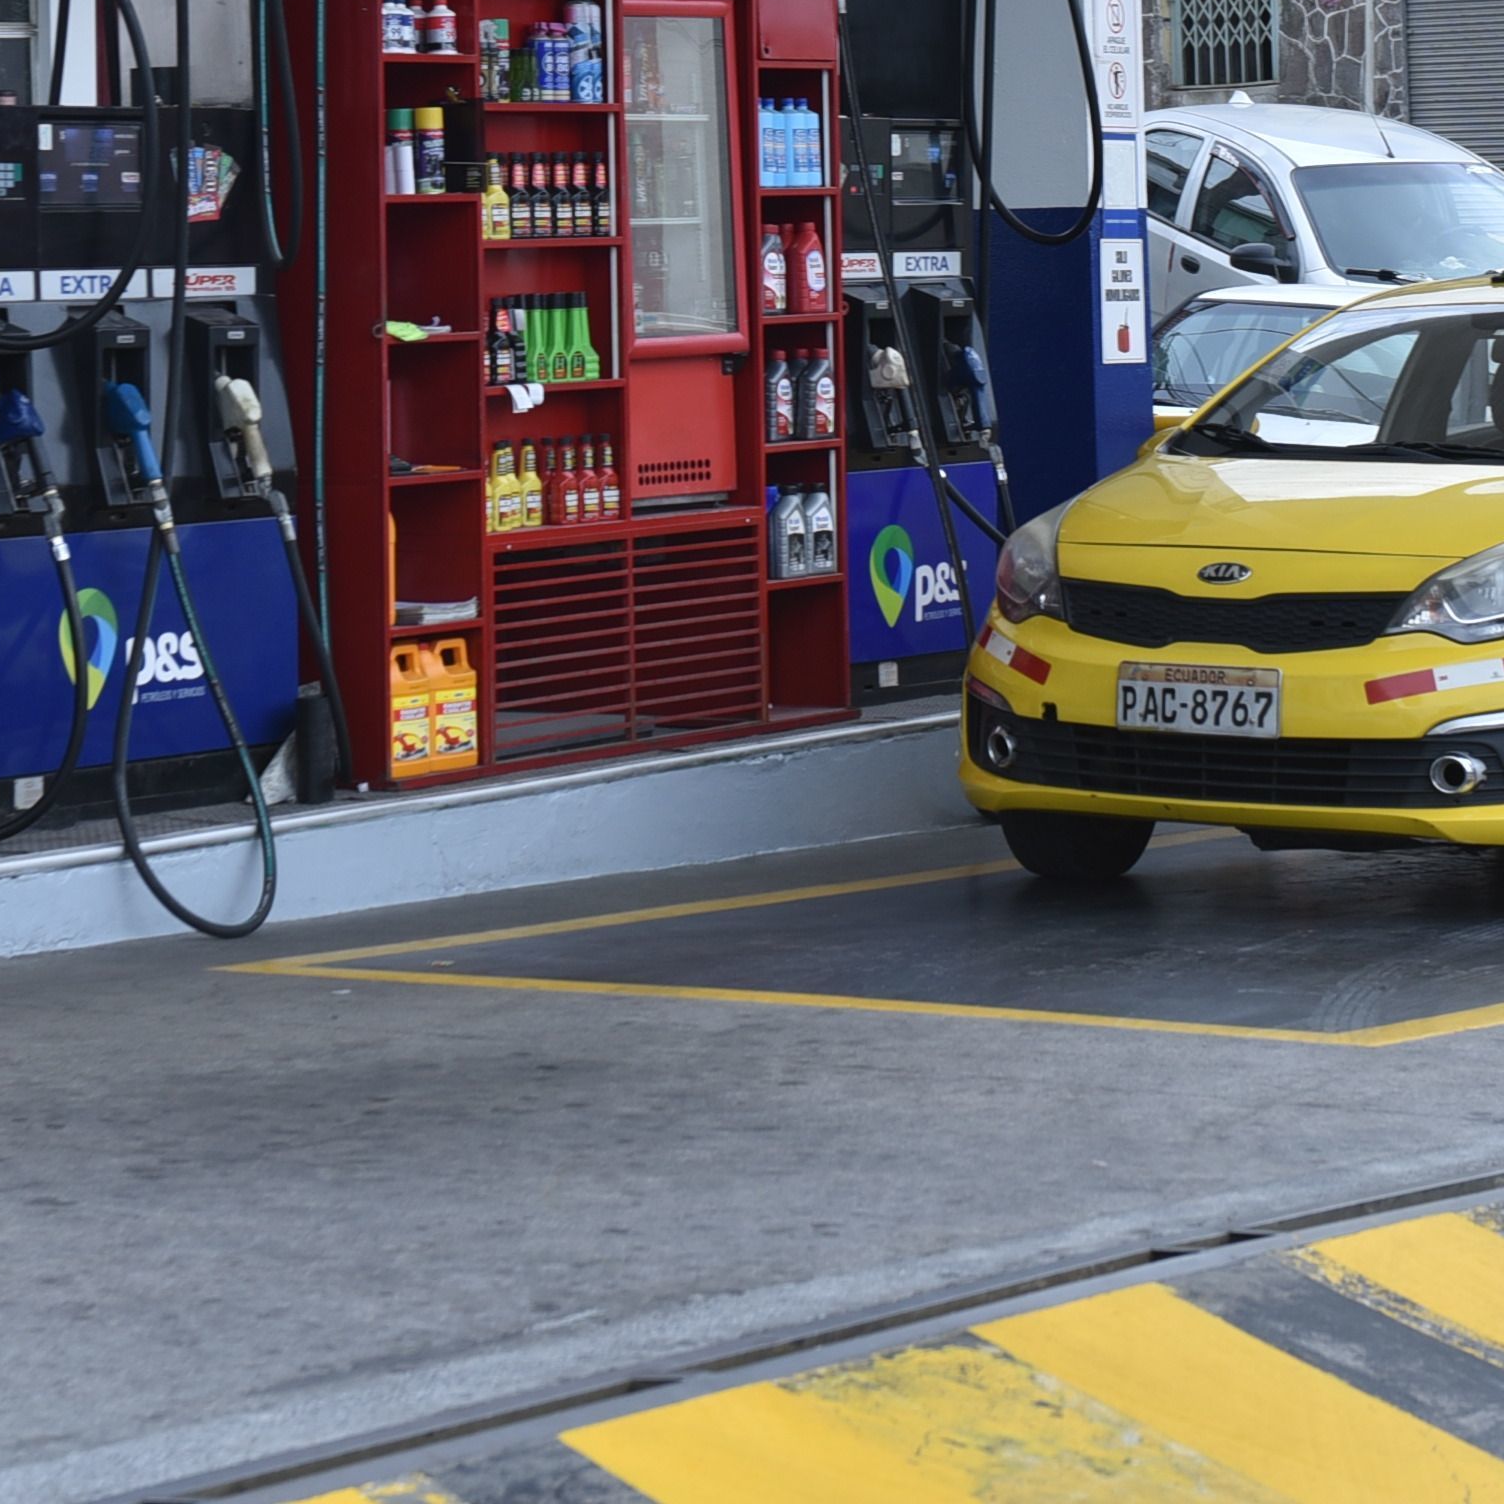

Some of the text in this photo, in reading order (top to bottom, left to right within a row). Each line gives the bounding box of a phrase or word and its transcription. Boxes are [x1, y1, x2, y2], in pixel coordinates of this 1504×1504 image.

[905, 255, 950, 272] EXTRA
[60, 275, 128, 295] EXTR
[1200, 564, 1242, 579] KIA
[1164, 667, 1227, 684] ECUADOR
[1121, 685, 1274, 729] PAC-8767
